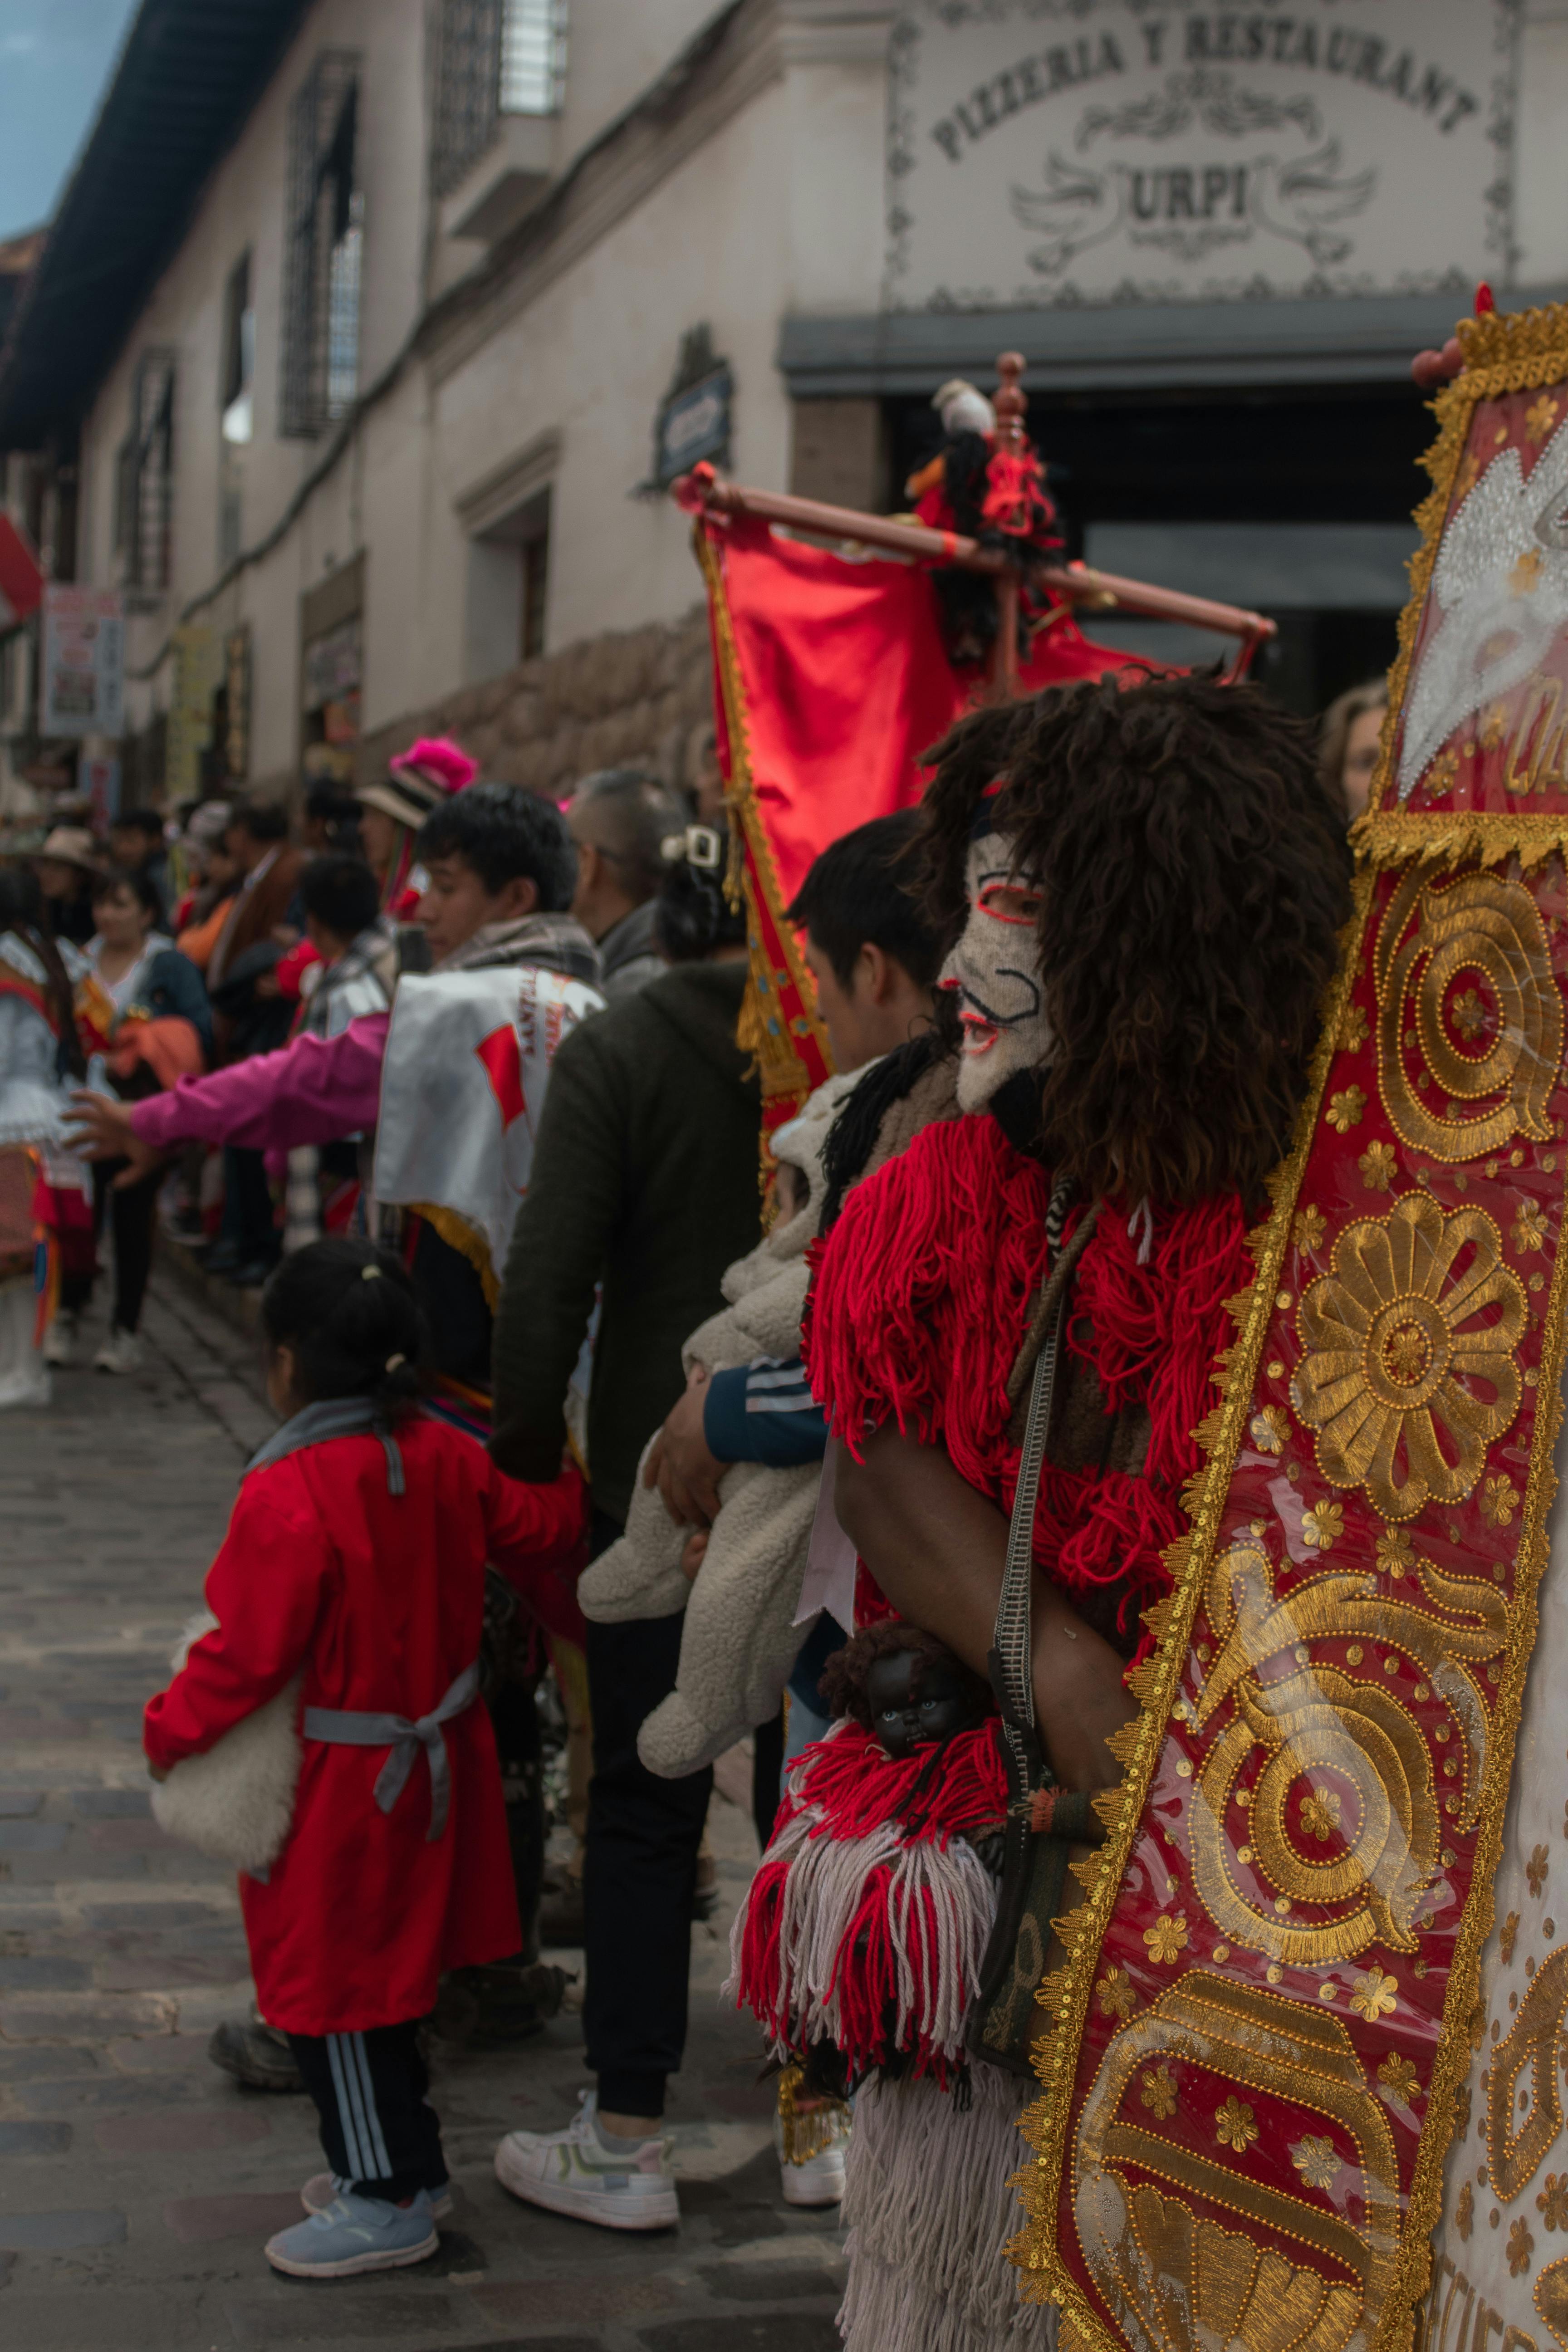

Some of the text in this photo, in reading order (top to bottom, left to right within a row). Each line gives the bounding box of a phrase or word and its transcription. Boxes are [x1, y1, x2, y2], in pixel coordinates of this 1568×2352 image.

[931, 15, 1477, 160] PIZZERIA Y RESTAURANT
[1131, 164, 1249, 220] URPI
